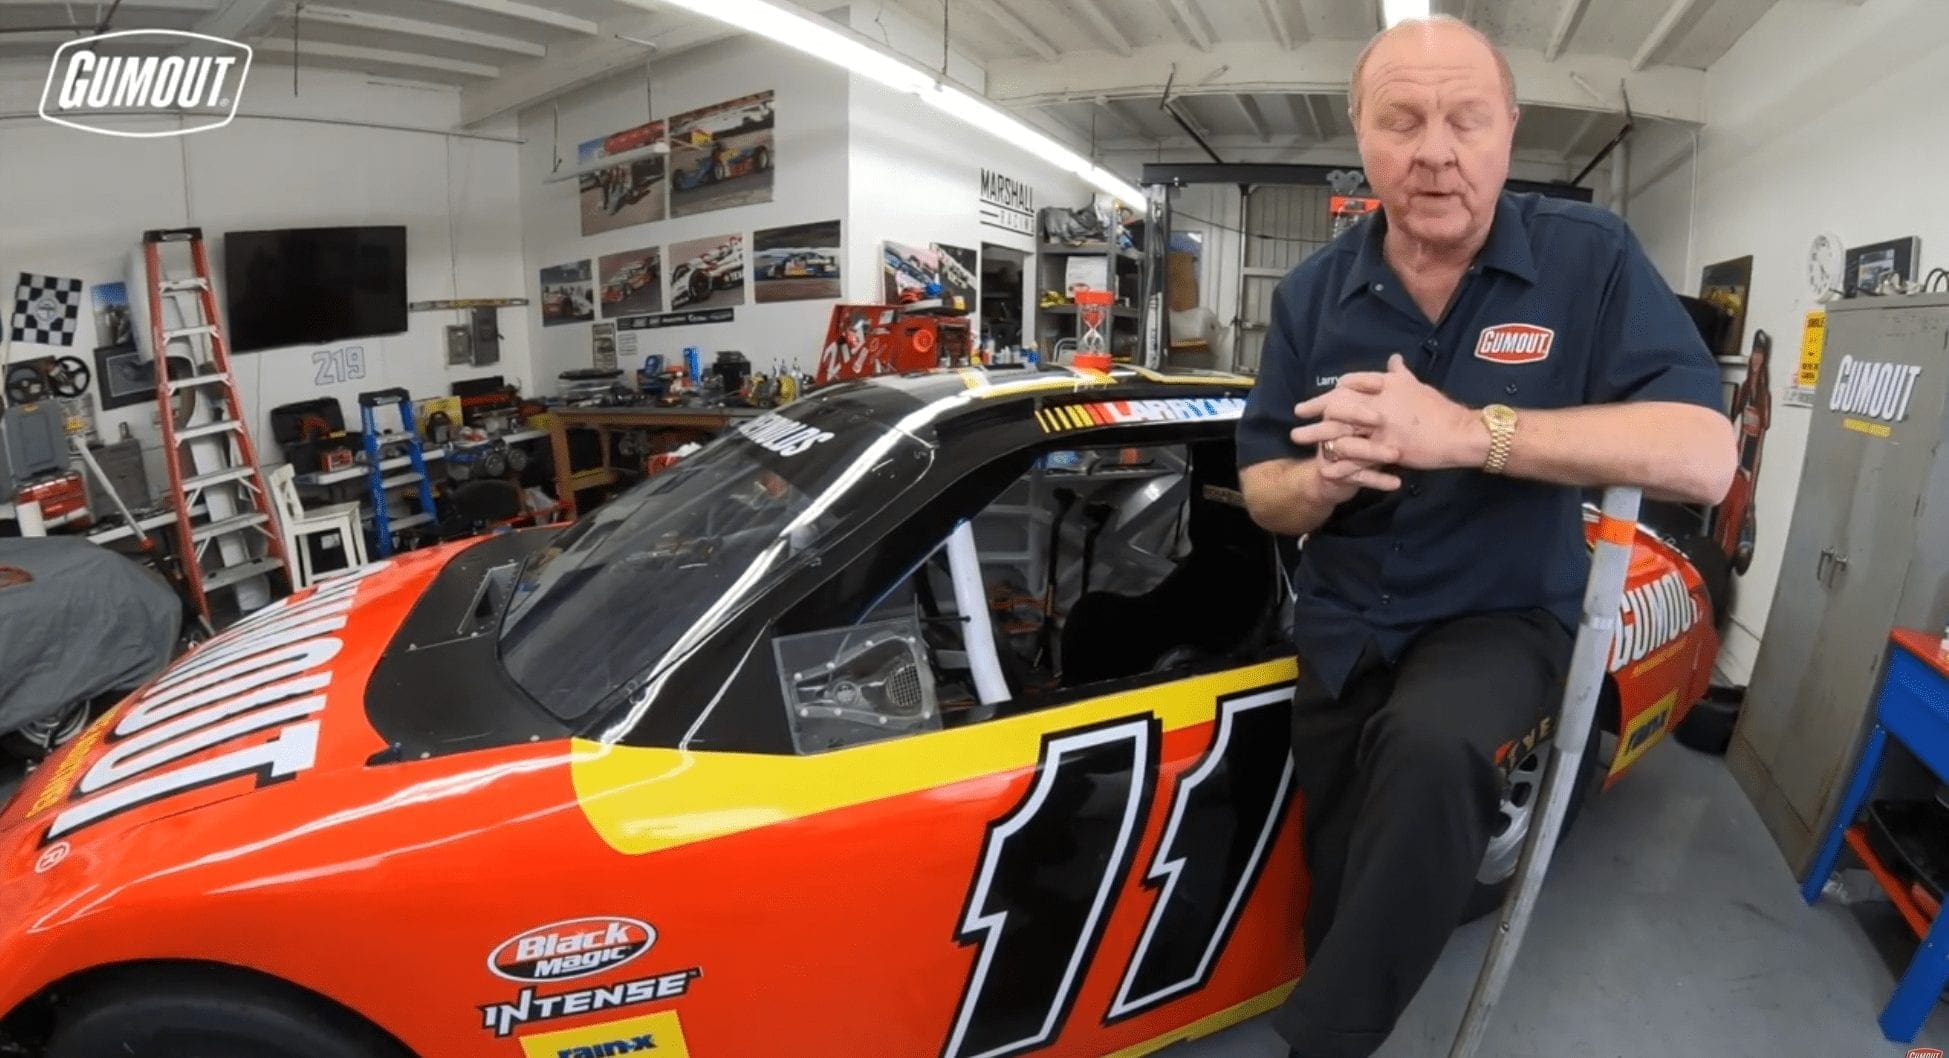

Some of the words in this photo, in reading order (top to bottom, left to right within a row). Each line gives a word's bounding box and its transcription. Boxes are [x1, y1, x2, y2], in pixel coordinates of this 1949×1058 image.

[981, 167, 1034, 213] MARSHALL
[1480, 330, 1549, 353] GUMOUT
[312, 346, 366, 386] 219
[1830, 354, 1922, 422] GUMOUT
[46, 560, 391, 840] GUMOUT
[941, 680, 1298, 1058] 11
[516, 922, 630, 961] Black
[534, 946, 627, 978] Magic
[484, 972, 688, 1036] INTENSE
